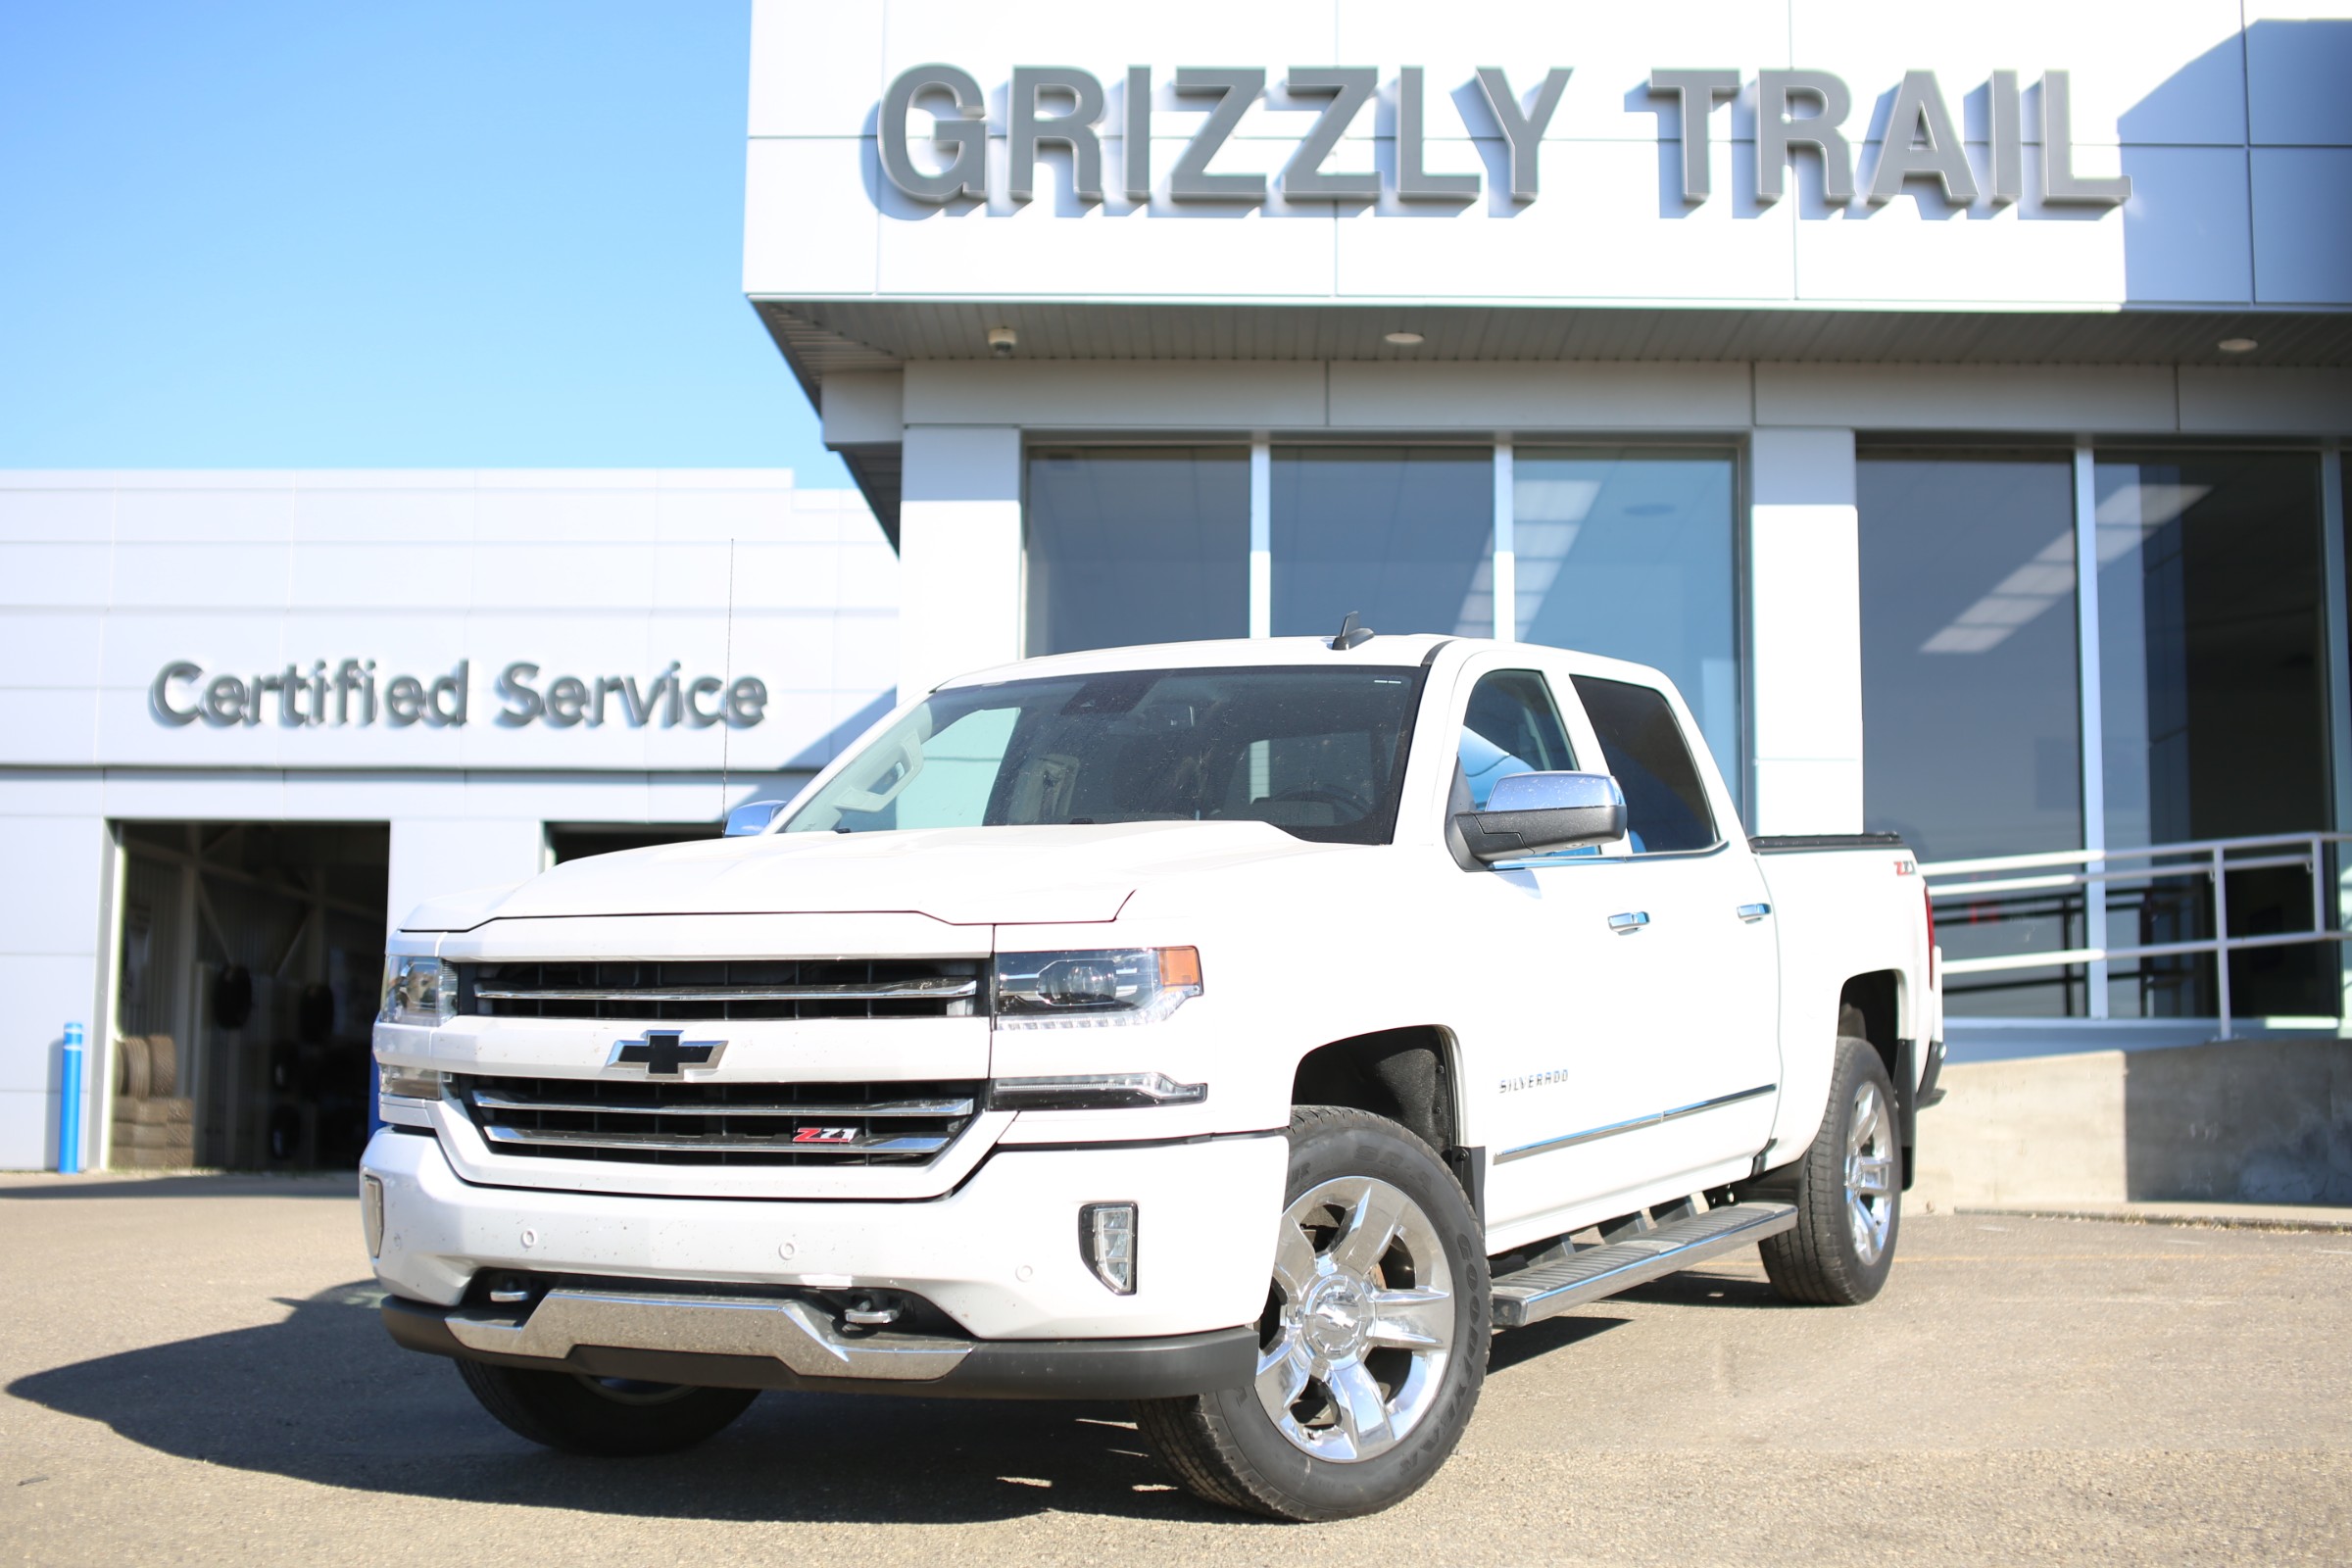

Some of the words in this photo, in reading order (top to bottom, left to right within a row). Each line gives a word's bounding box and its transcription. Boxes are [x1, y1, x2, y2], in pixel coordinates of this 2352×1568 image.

[876, 62, 1574, 202] GRIZZLY
[1647, 68, 2132, 206] TRAIL
[153, 658, 470, 726] Certified
[496, 660, 769, 726] Service
[1499, 1069, 1568, 1094] SILVERADO
[792, 1127, 858, 1143] Z71
[1399, 1232, 1481, 1477] GOODYEAR
